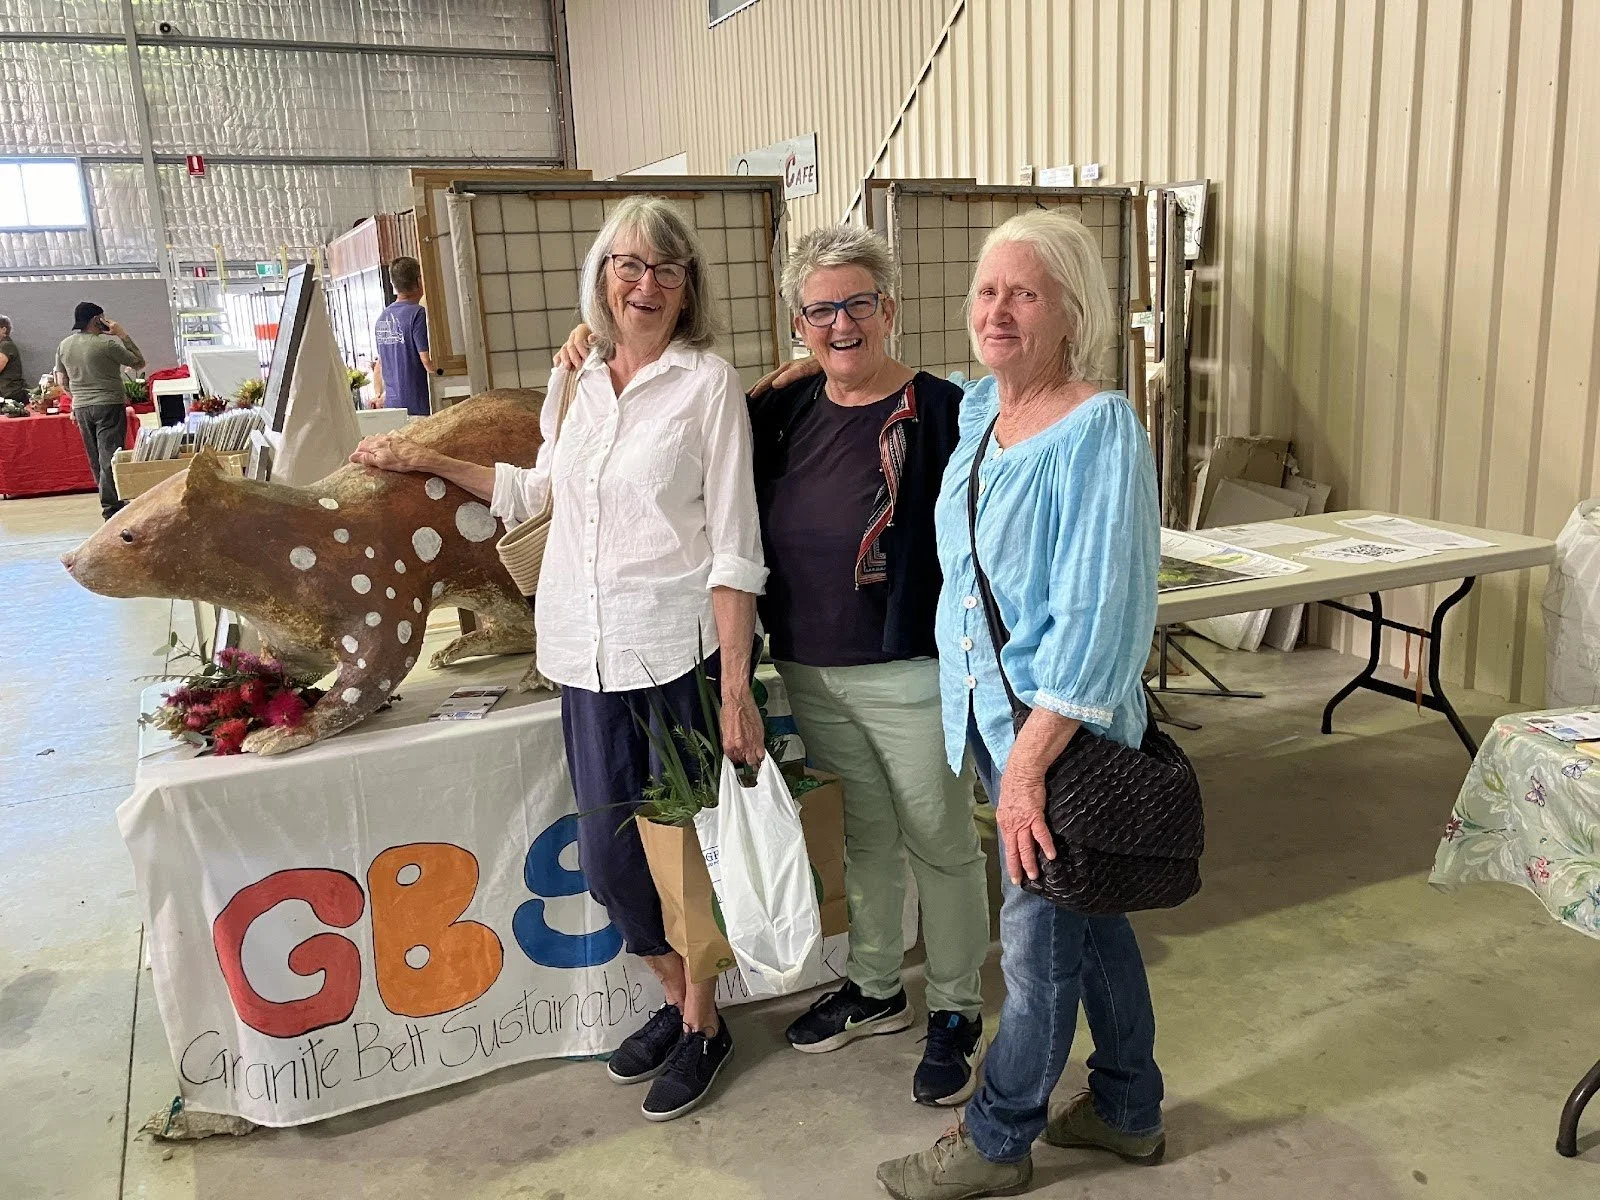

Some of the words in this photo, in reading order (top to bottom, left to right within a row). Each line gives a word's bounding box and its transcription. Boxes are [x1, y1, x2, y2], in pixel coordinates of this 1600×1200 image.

[784, 152, 815, 188] CAFE
[180, 1030, 342, 1104] Granite
[353, 1022, 431, 1082] Belt
[439, 965, 647, 1068] Sustainable
